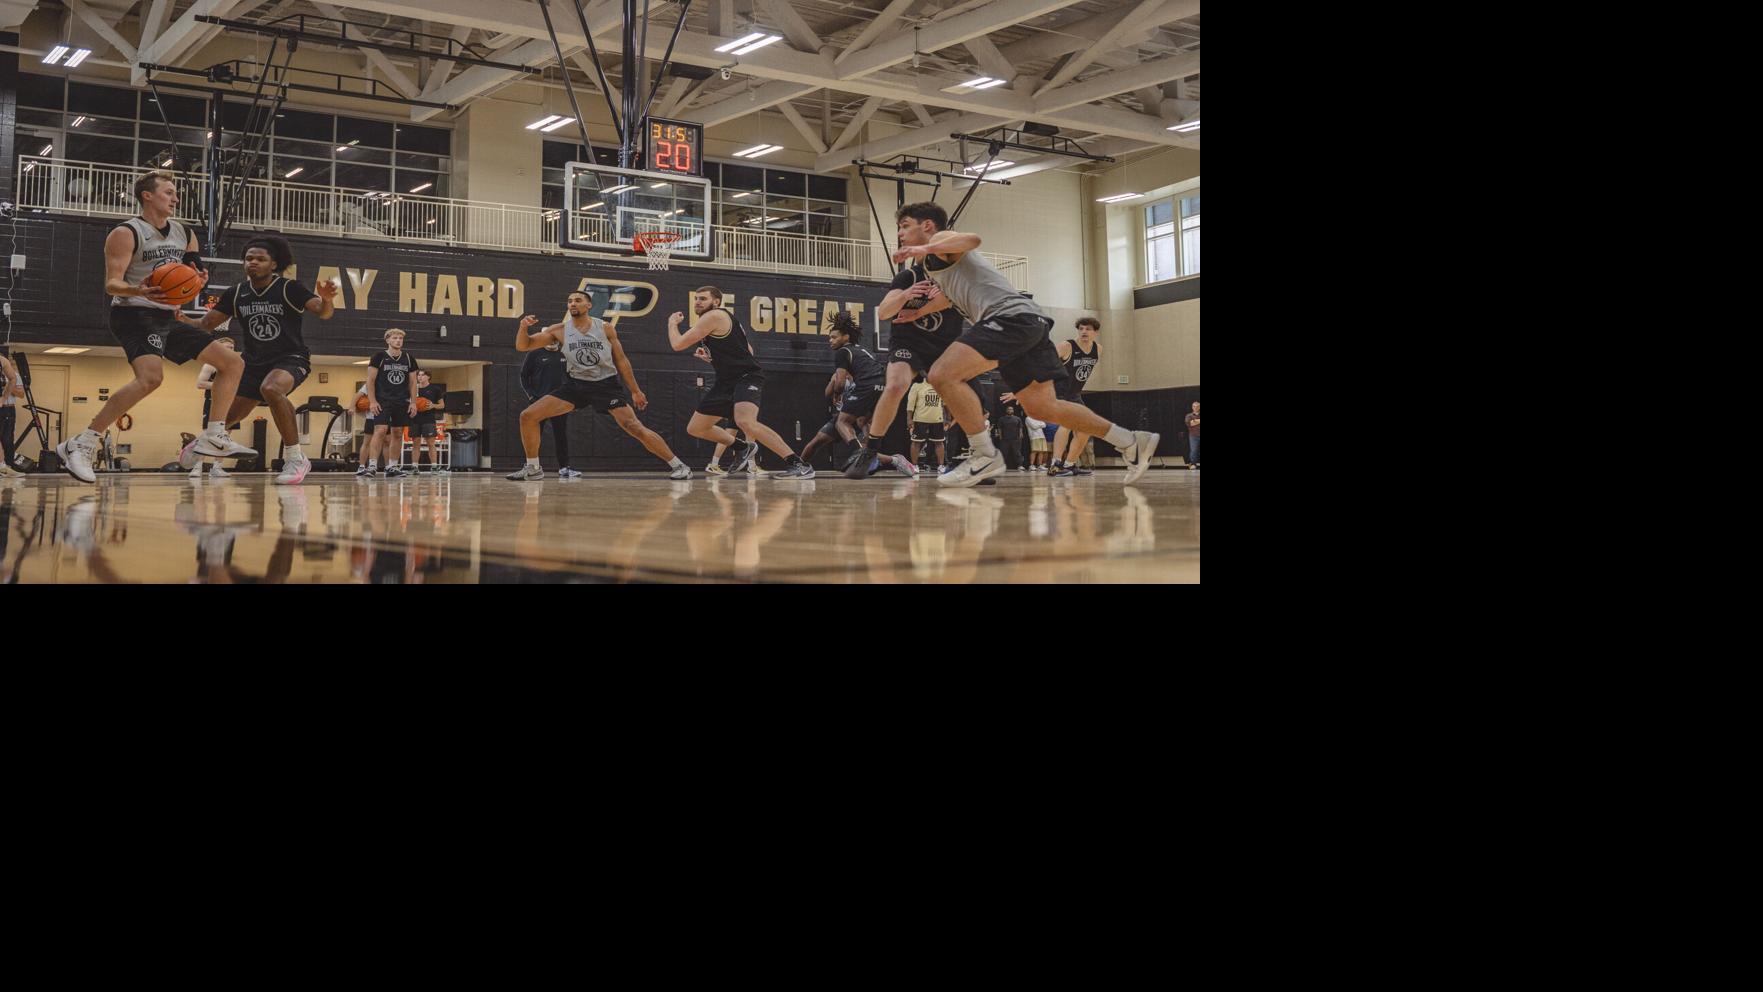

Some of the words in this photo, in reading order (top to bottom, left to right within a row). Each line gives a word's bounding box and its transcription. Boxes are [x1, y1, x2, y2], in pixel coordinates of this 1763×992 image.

[656, 141, 690, 170] 20
[283, 264, 378, 310] AY
[398, 271, 524, 319] HARD
[750, 295, 864, 336] GREAT
[257, 324, 273, 338] 24
[393, 375, 401, 383] 14
